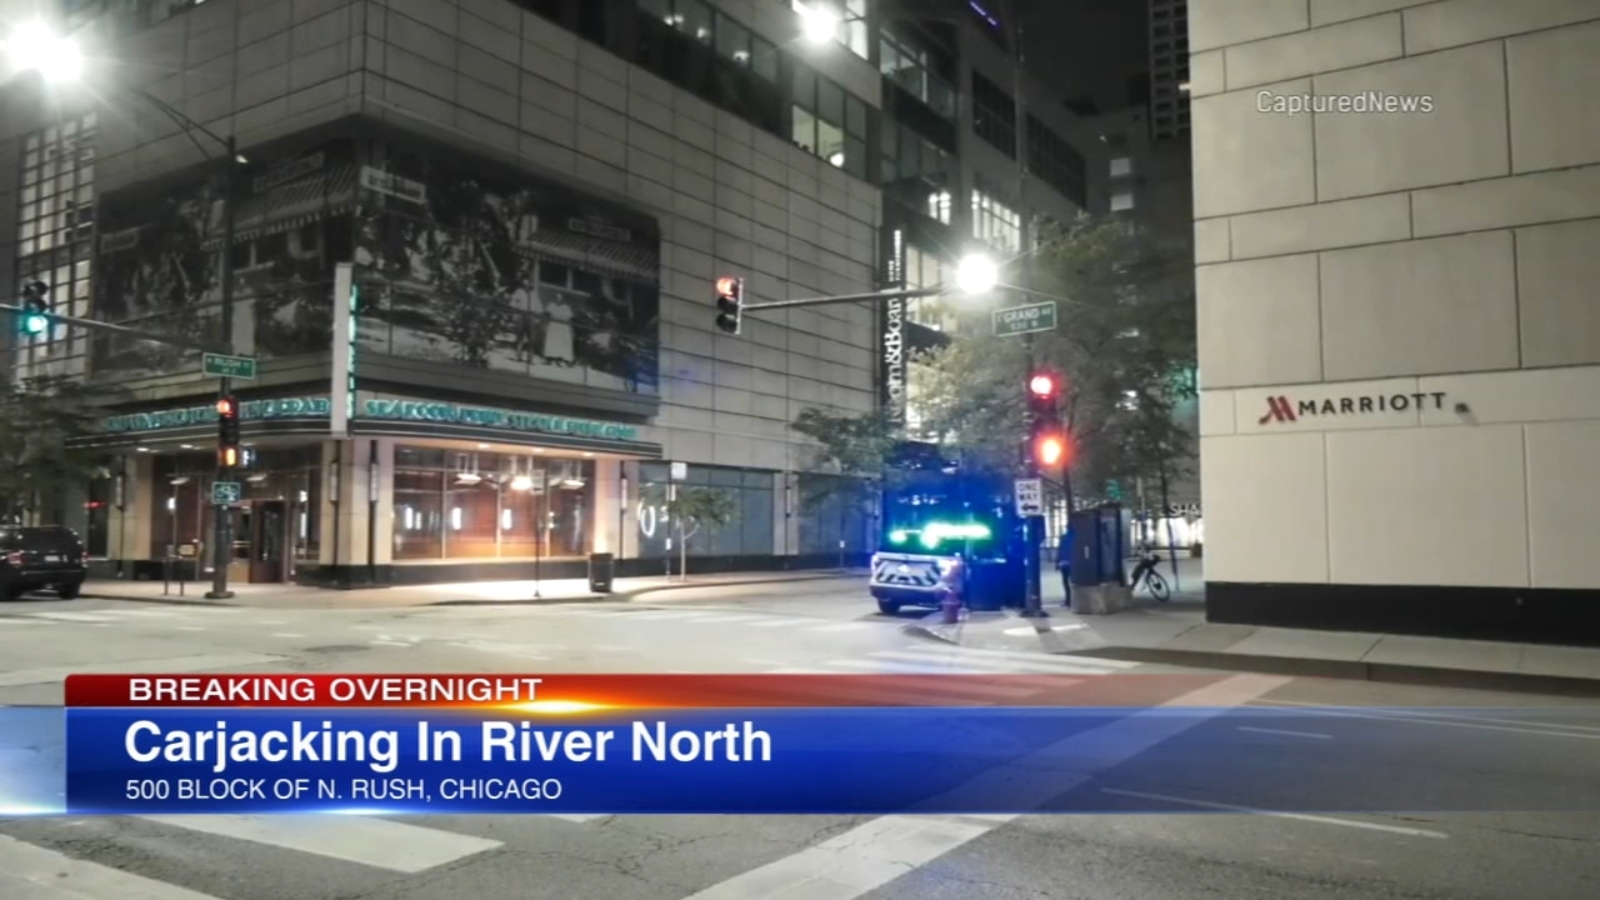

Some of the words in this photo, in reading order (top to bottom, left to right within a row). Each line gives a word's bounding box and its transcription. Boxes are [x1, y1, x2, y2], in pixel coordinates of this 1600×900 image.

[1003, 307, 1040, 324] GRAND
[1298, 391, 1446, 416] MARRIOTT
[1018, 482, 1038, 491] ONE
[1018, 492, 1038, 501] WAY
